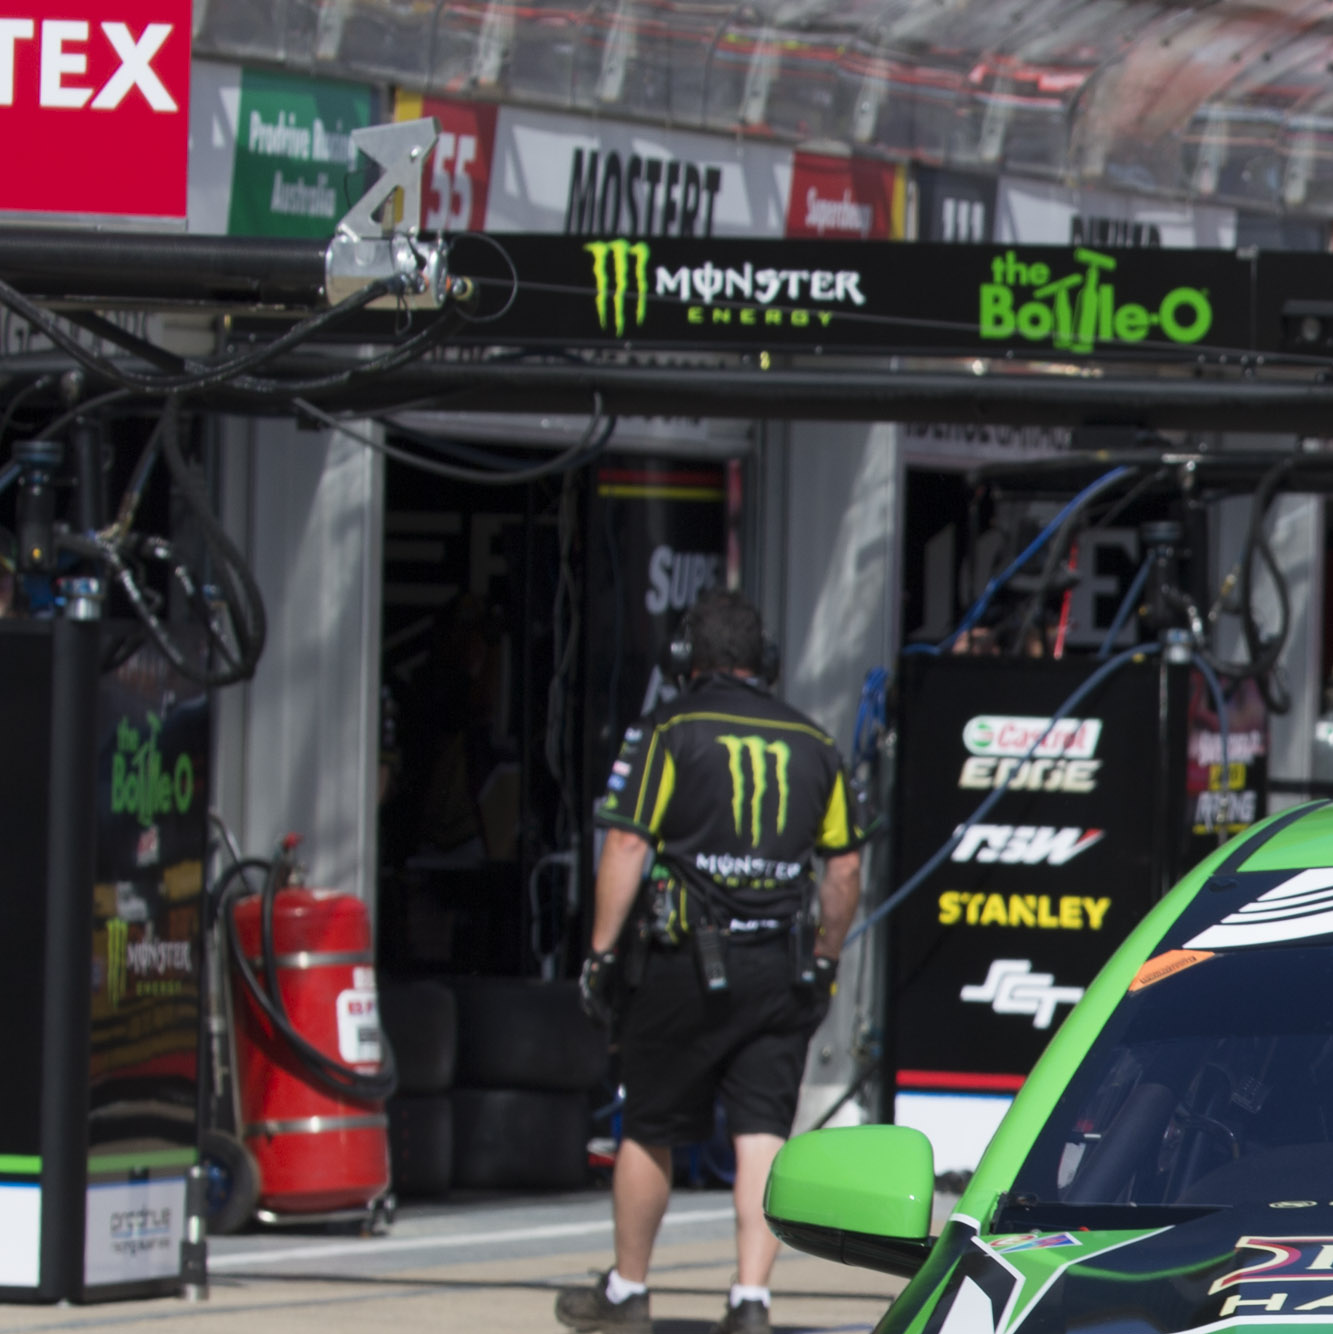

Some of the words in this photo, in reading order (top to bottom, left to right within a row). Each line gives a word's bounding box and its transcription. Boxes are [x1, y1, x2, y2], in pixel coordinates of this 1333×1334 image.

[566, 147, 722, 237] MOSTERT
[656, 260, 866, 305] MONSTER
[992, 250, 1050, 287] the
[687, 306, 834, 327] ENERGY
[996, 722, 1087, 749] Castrol
[958, 756, 1101, 792] EDGE
[938, 891, 1111, 930] STANLEY
